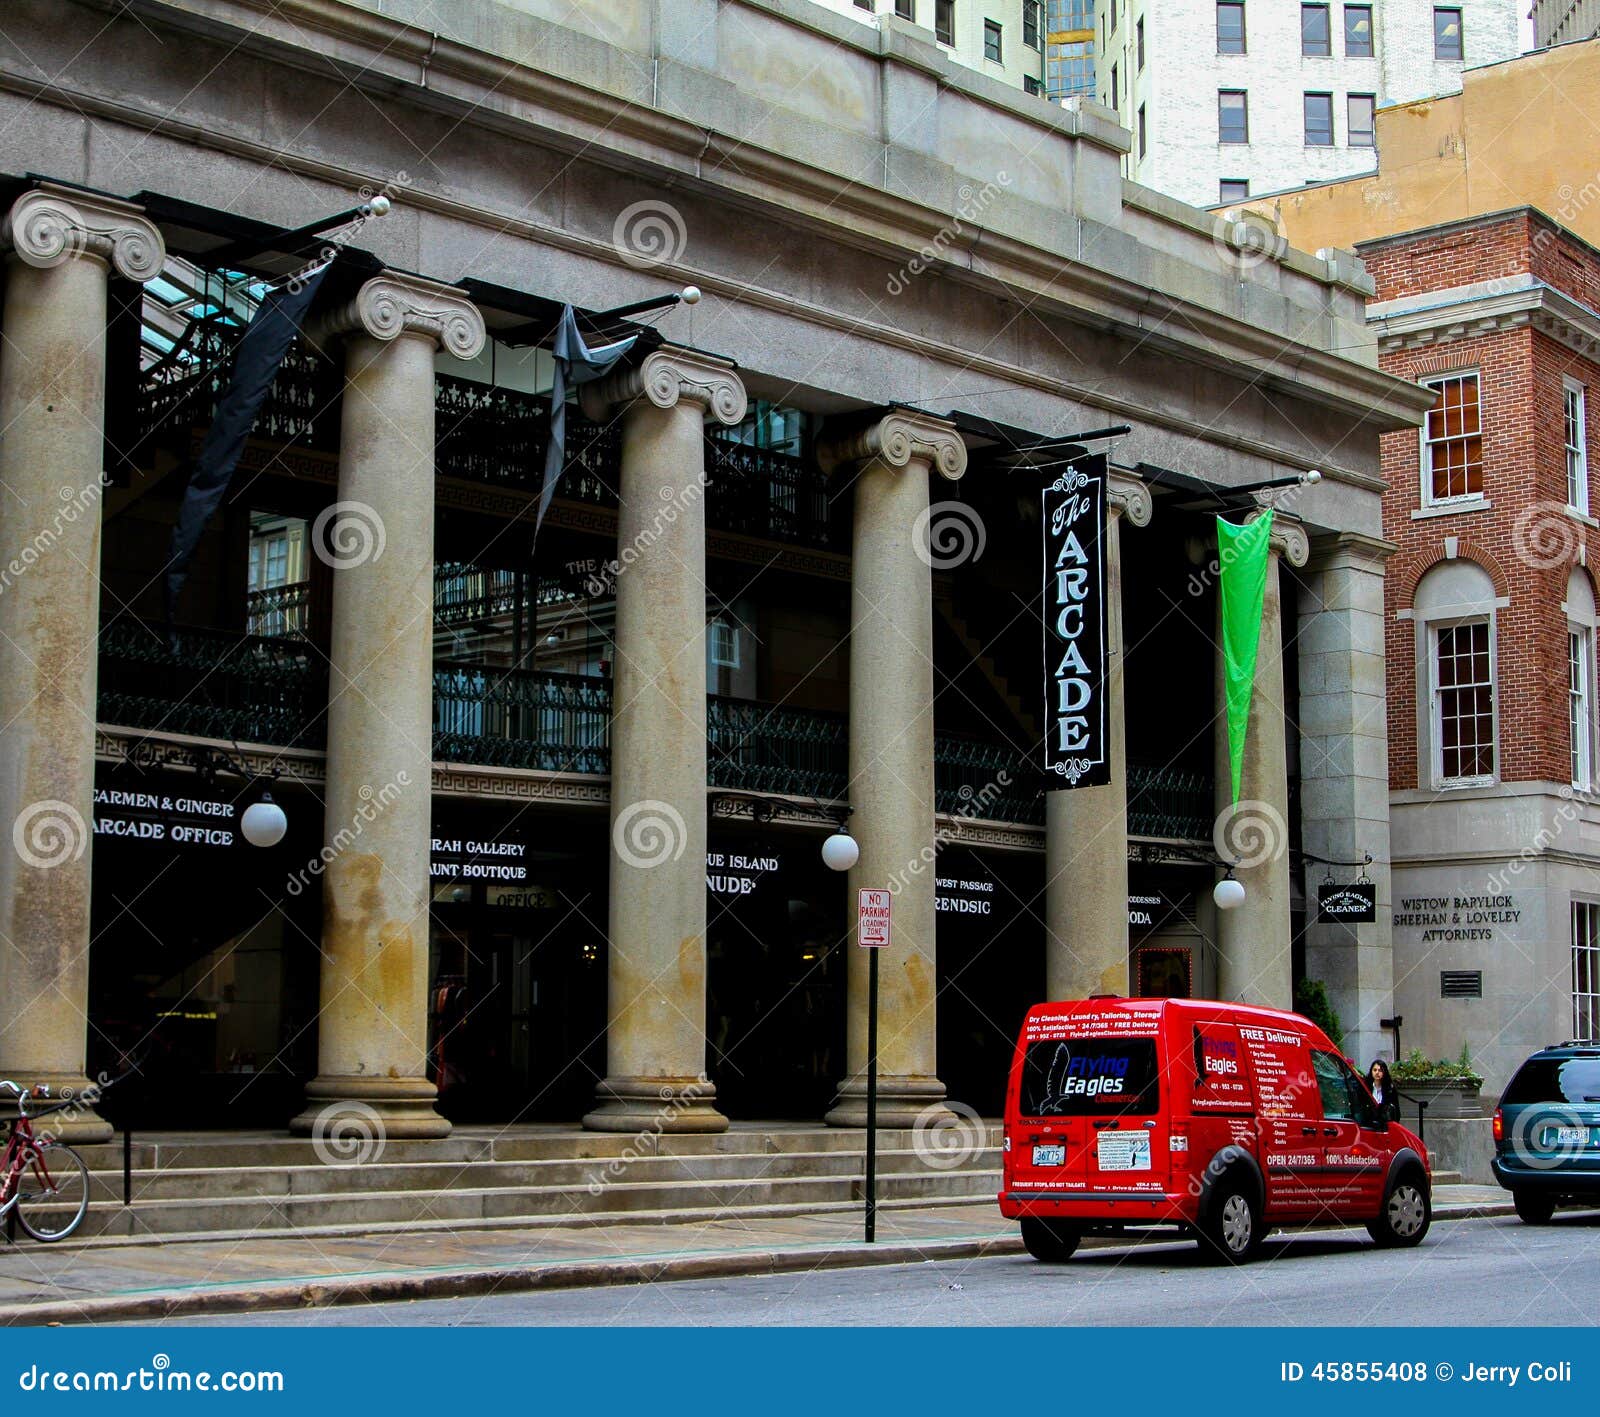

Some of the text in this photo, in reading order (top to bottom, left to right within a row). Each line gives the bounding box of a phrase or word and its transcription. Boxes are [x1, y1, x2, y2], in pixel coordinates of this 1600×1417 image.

[1051, 494, 1089, 536] The
[1055, 531, 1091, 751] ARCADE
[161, 797, 172, 810] &
[175, 798, 234, 818] GINGER
[92, 818, 233, 846] ARCADE OFFICE
[430, 838, 526, 856] RAH GALLERY
[706, 853, 778, 871] UE ISLAND
[463, 864, 527, 879] BOUTIQUE
[960, 880, 994, 892] PASSAGE
[497, 893, 547, 909] OFFICE
[868, 894, 881, 905] NO
[1320, 891, 1373, 908] FLYING EAGLES
[1402, 898, 1449, 911] WISTOW
[861, 907, 889, 917] PARKING
[1326, 905, 1367, 913] CLEANER
[863, 919, 888, 928] LOADING
[1128, 911, 1152, 924] ODA
[1393, 911, 1521, 926] SHEEHAN & LOVELEY
[868, 927, 882, 936] ZONE
[1422, 929, 1493, 942] ATTORNEYS
[1041, 1013, 1070, 1022] Cleaning,
[1101, 1011, 1132, 1020] Tailoring,
[1133, 1009, 1161, 1019] Storage
[1026, 1025, 1041, 1033] 100%
[1043, 1023, 1077, 1032] Satisfaction
[1114, 1021, 1131, 1029] FREE
[1132, 1020, 1159, 1029] Delivery
[1240, 1028, 1301, 1047] FREE Delivery
[1069, 1055, 1129, 1078] Flying
[1205, 1055, 1238, 1075] Eagles
[1064, 1075, 1124, 1096] Eagles
[1037, 1150, 1060, 1161] 36775
[1267, 1154, 1379, 1166] OPEN 24/7/365 100% Satisfaction
